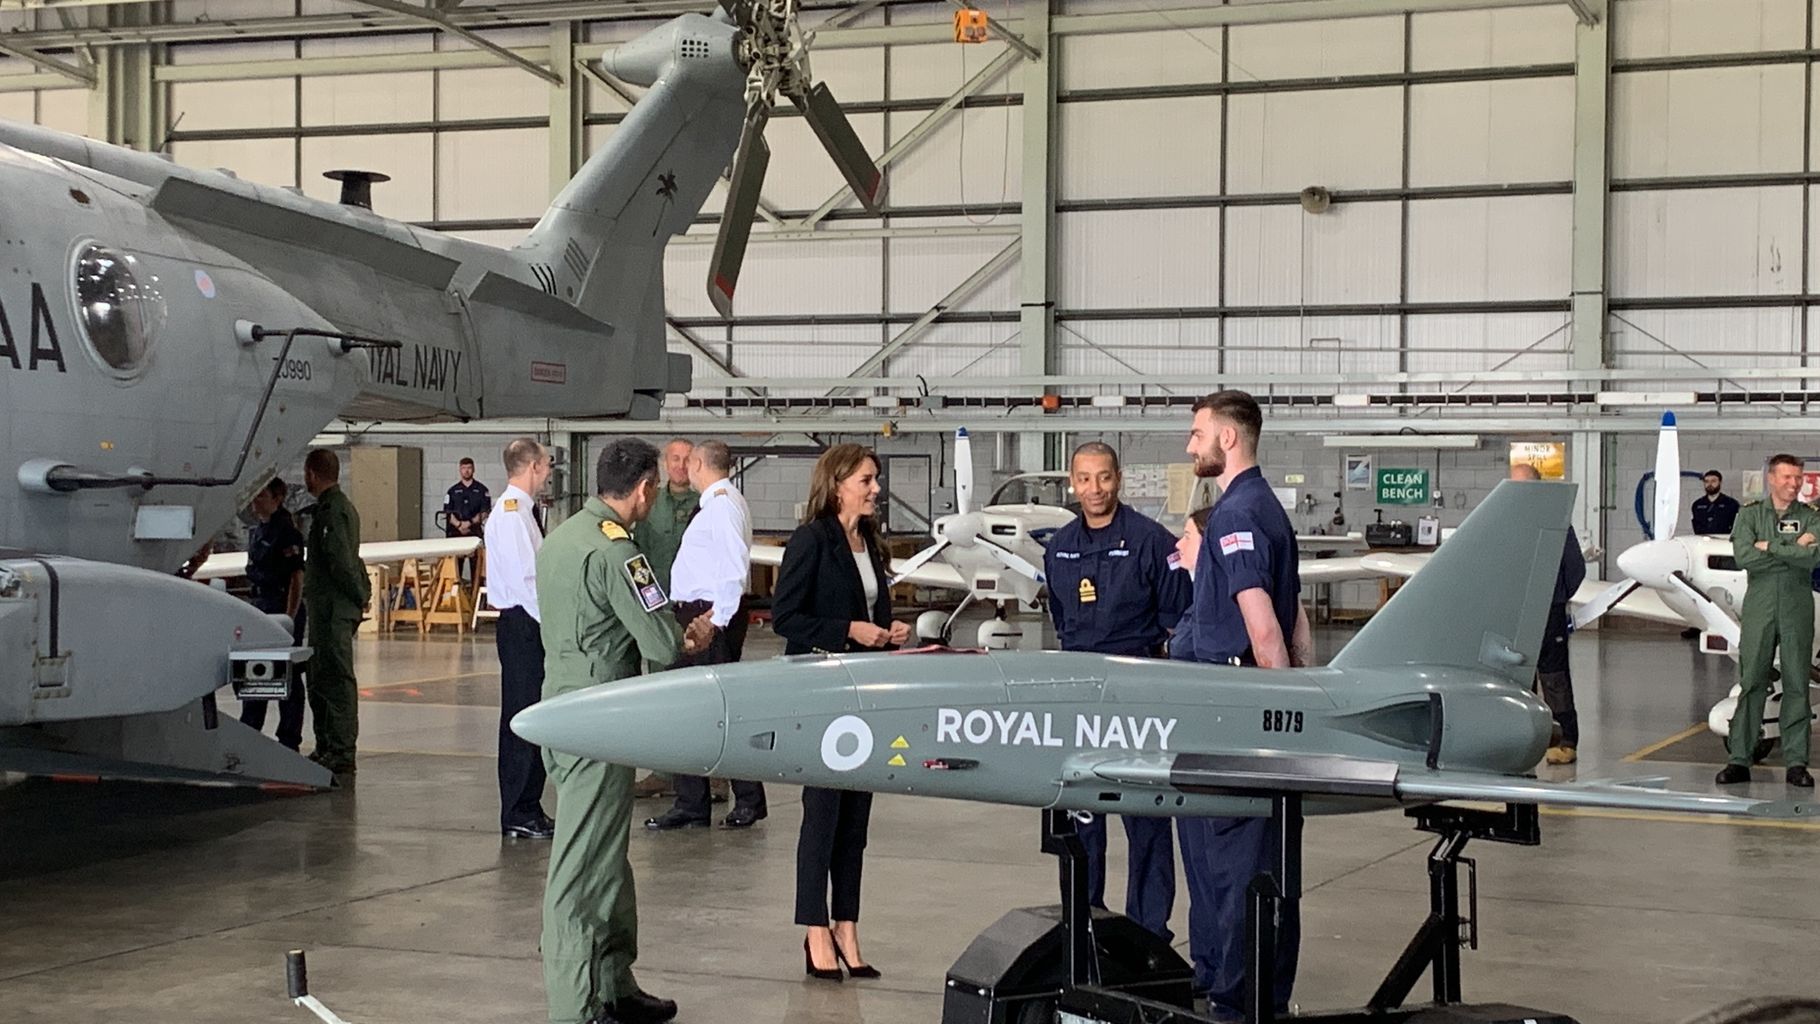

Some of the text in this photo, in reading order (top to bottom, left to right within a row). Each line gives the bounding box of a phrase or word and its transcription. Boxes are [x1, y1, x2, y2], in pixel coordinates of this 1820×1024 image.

[413, 343, 461, 393] NAVY
[1383, 473, 1422, 484] CLEAN
[1382, 488, 1423, 499] BENCH
[936, 708, 1177, 749] ROYAL NAVY
[1263, 709, 1304, 733] 8879
